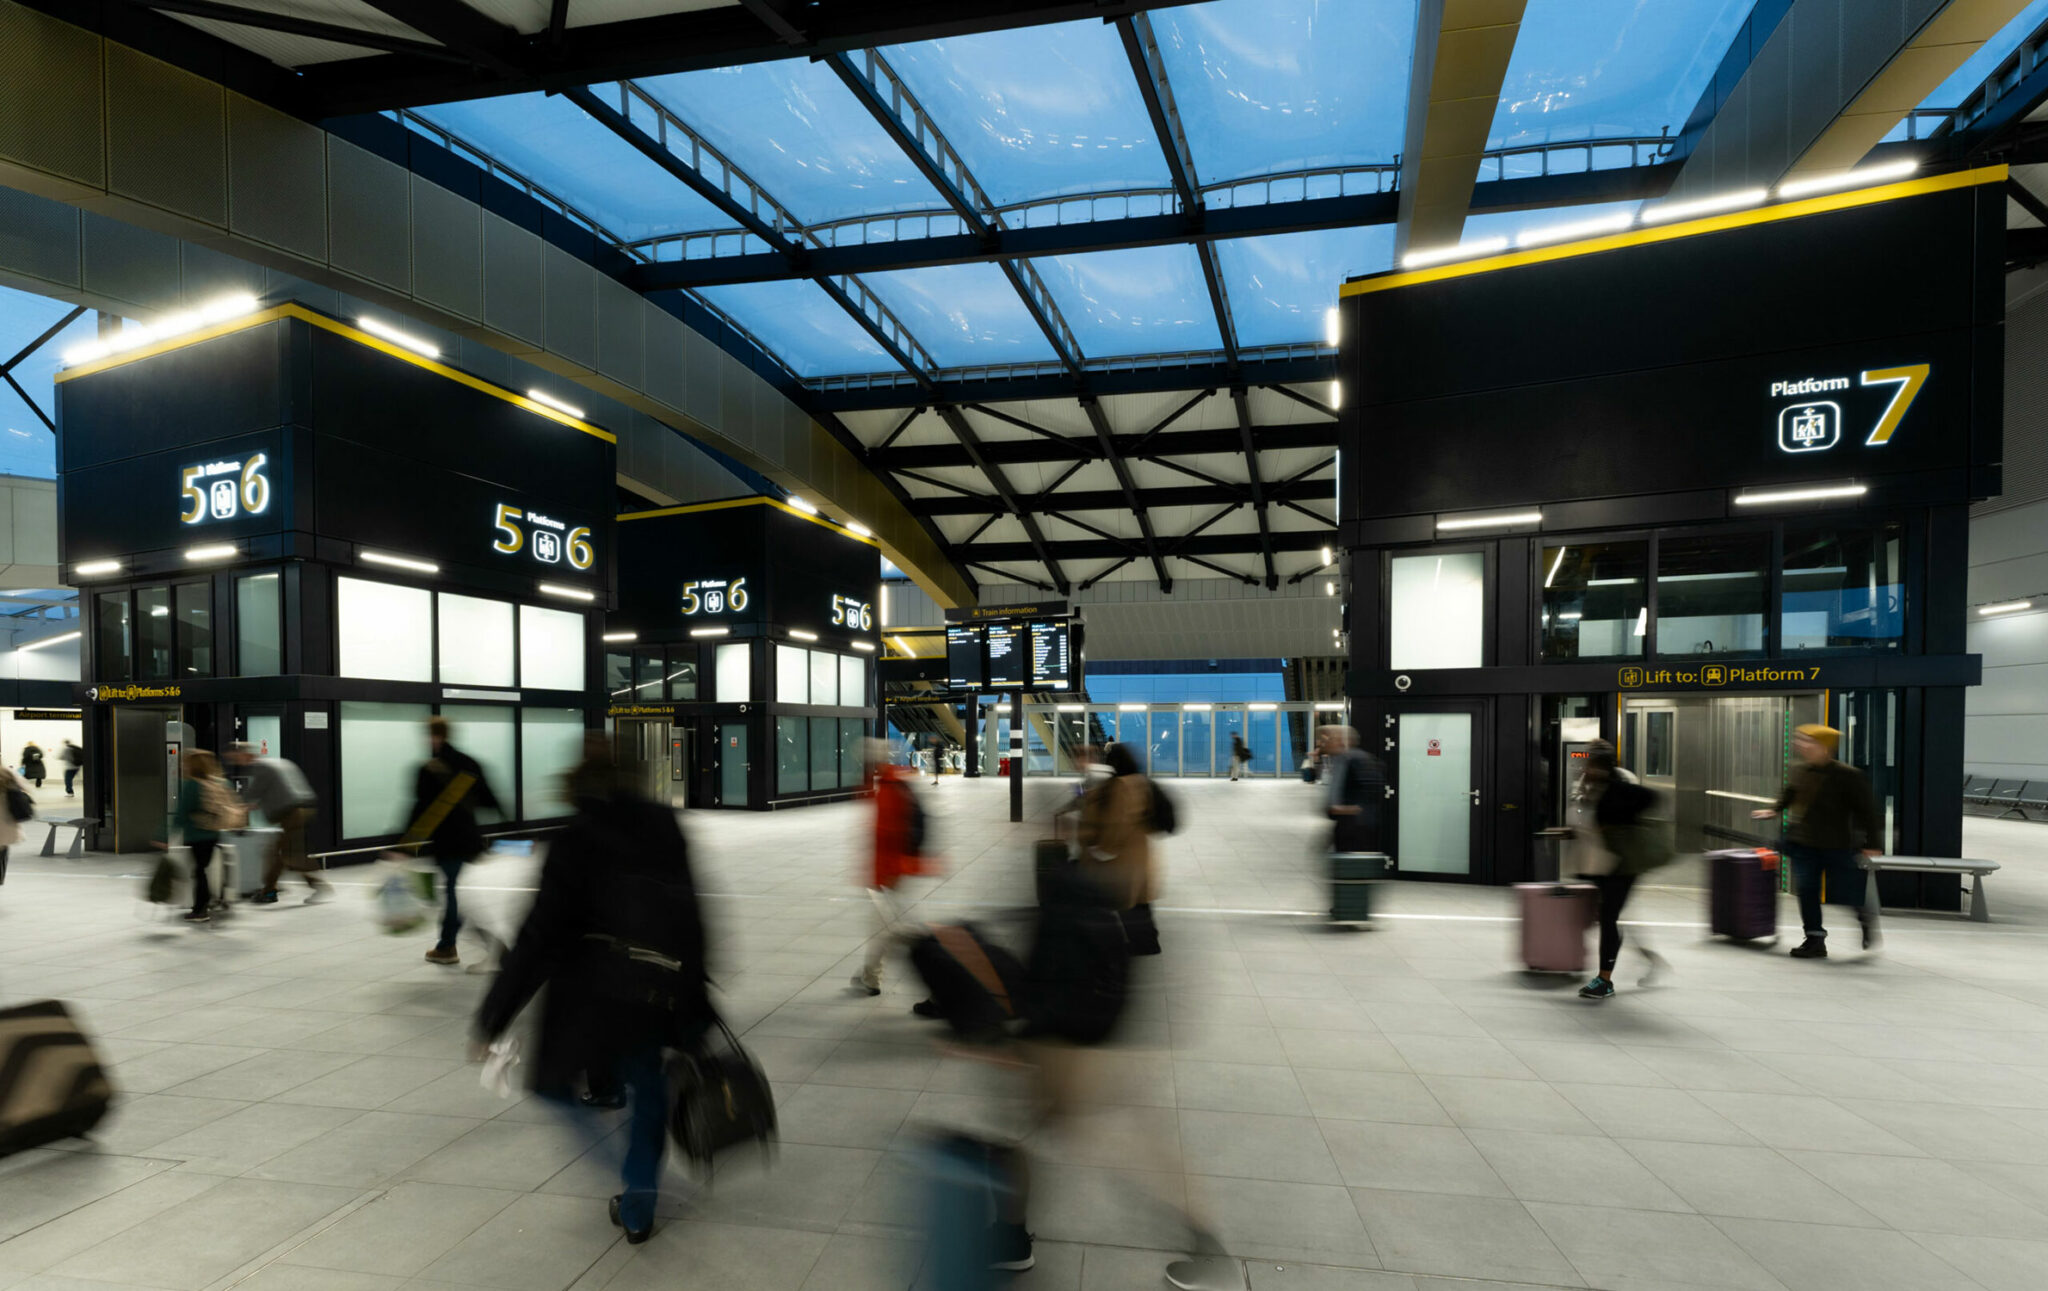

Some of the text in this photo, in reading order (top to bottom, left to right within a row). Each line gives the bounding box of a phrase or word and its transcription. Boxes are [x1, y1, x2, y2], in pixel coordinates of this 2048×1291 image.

[1771, 363, 1930, 446] Platform 7
[180, 453, 269, 524] 5 6
[527, 511, 565, 530] Platforms
[493, 503, 594, 570] 5 6
[681, 577, 748, 615] 5 6
[832, 594, 872, 631] 5 6
[982, 606, 1038, 617] Train information
[1645, 667, 1821, 683] Lift to: Platform 7
[108, 688, 118, 698] Lift
[136, 687, 164, 697] Platforms
[164, 687, 169, 696] 5
[169, 687, 175, 696] &
[175, 687, 181, 696] 6
[18, 711, 48, 720] Airport
